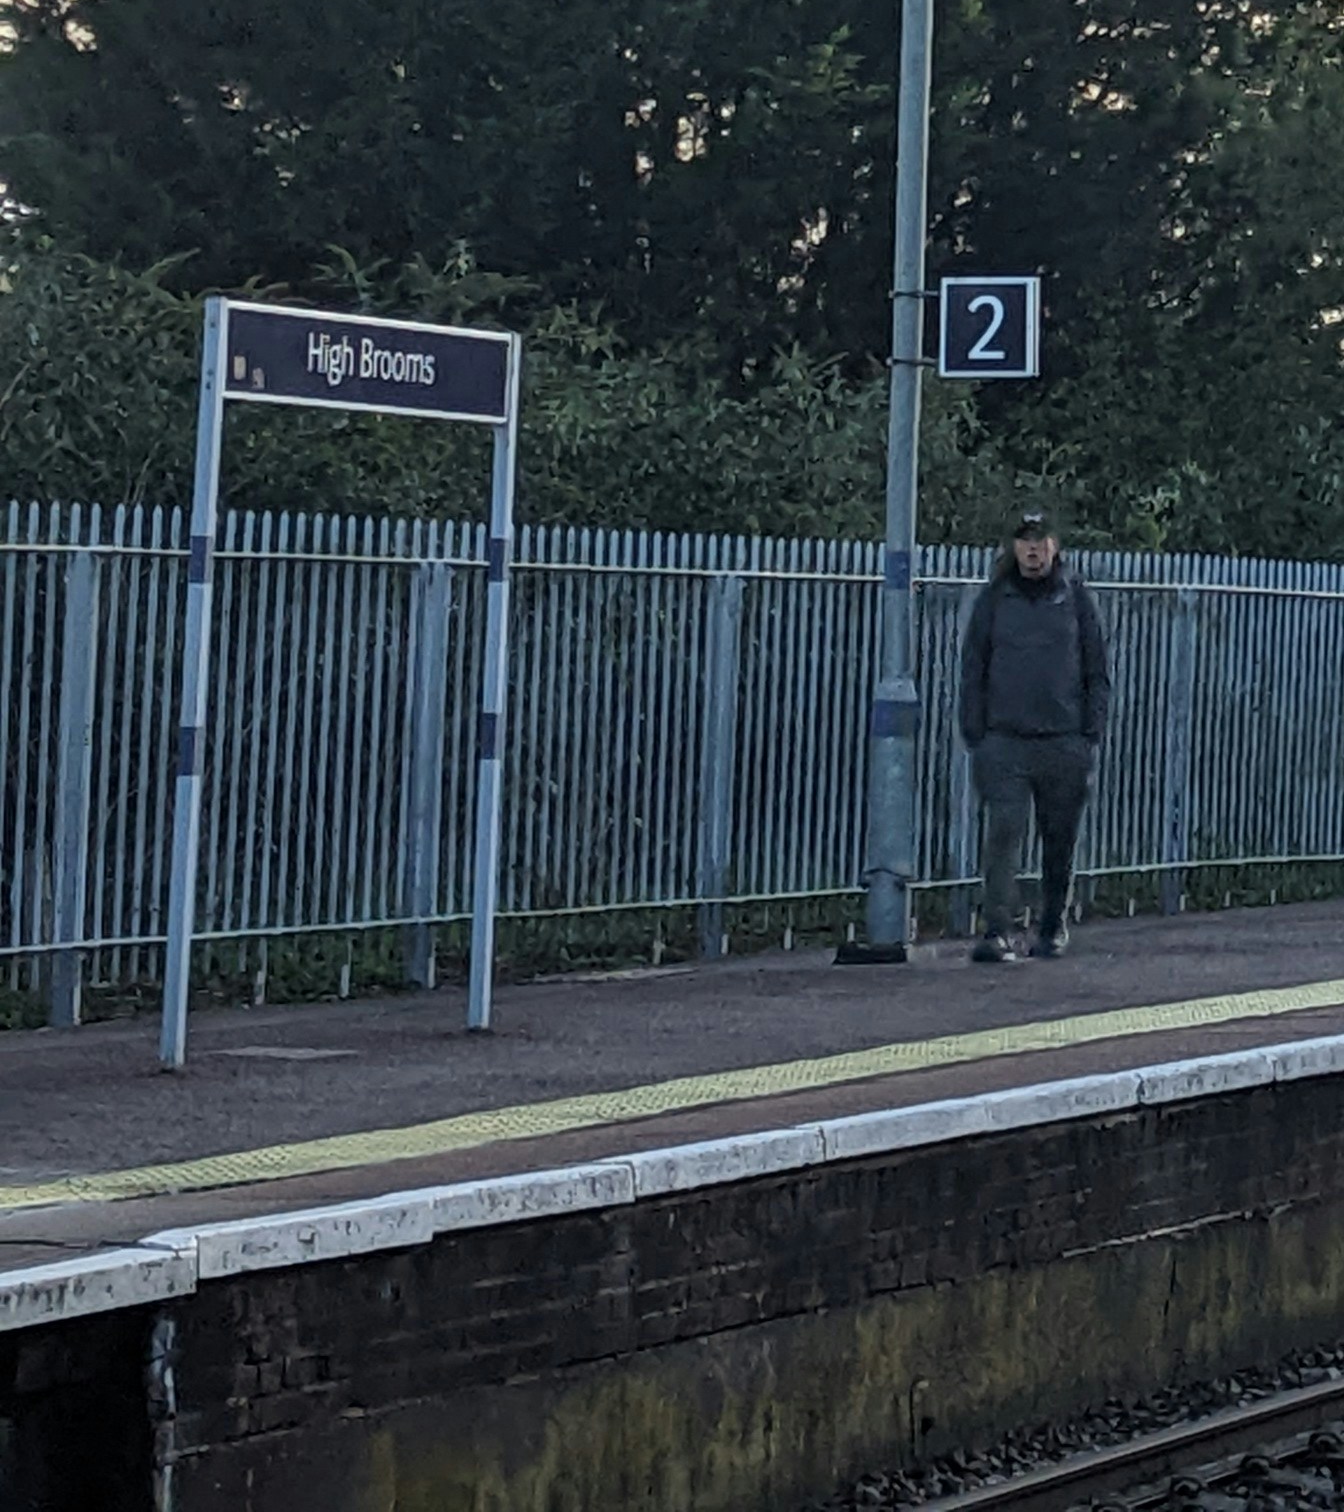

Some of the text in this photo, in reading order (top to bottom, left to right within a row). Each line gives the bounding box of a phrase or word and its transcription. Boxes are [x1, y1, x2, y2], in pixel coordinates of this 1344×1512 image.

[967, 294, 1005, 360] 2
[306, 332, 436, 387] High Brooms
